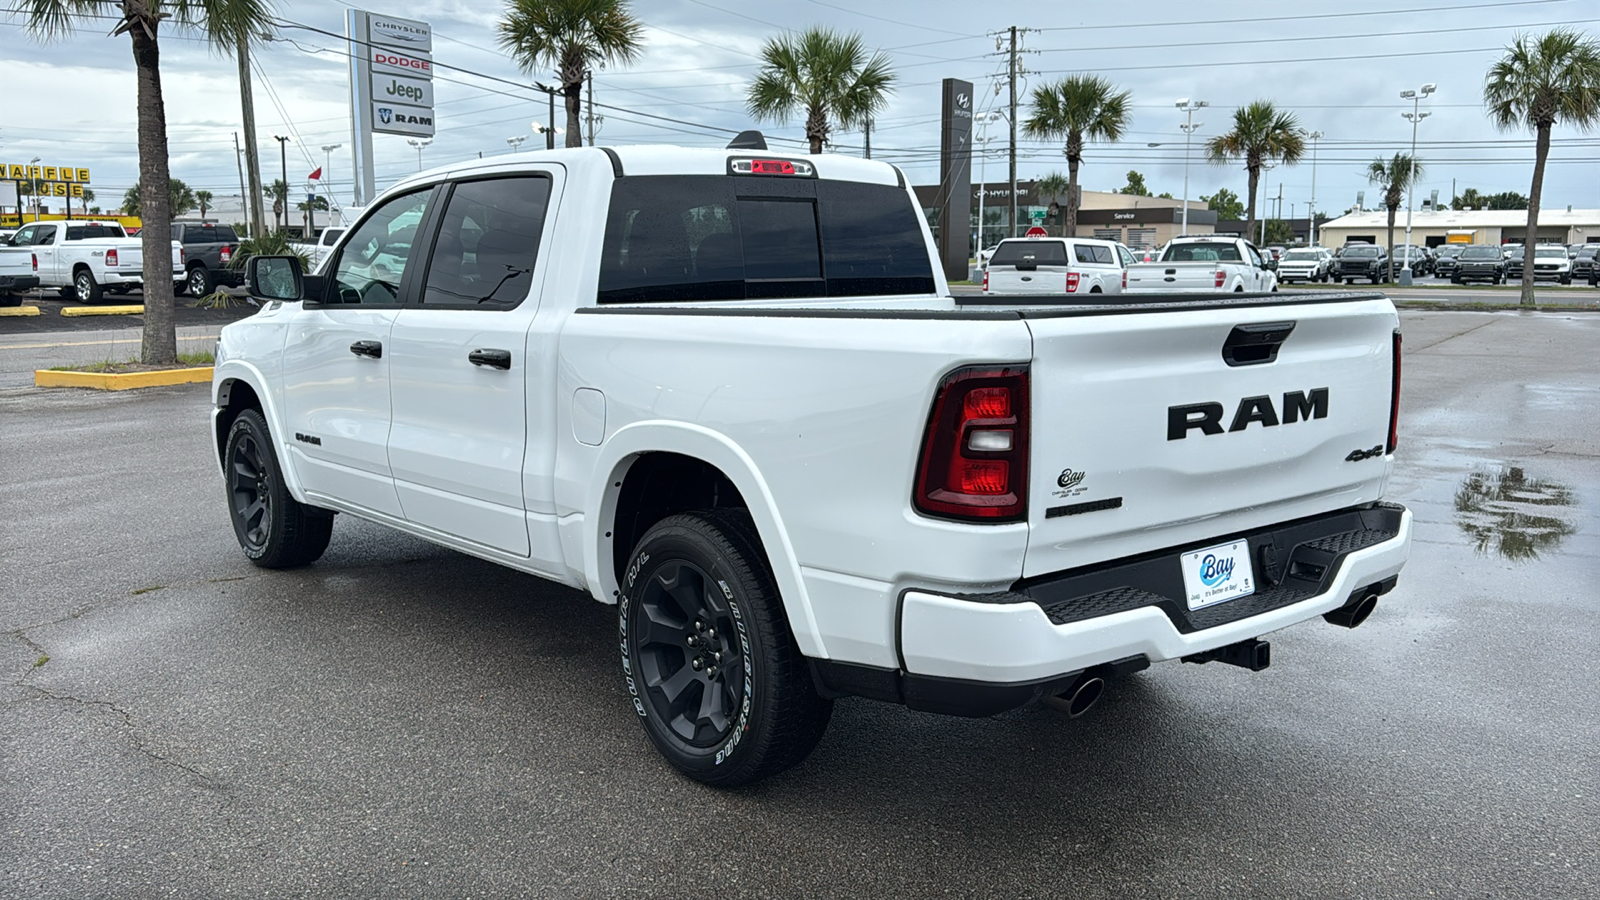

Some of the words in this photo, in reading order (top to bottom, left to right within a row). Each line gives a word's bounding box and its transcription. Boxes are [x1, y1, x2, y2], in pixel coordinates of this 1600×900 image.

[375, 21, 428, 35] CHRYSLER
[375, 54, 430, 70] DODGE
[386, 80, 423, 102] Jeep
[395, 114, 432, 126] RAM
[1113, 212, 1135, 220] Service
[1167, 387, 1329, 441] RAM
[1345, 444, 1383, 462] 4x4
[1058, 468, 1086, 488] Bay
[1202, 554, 1236, 581] Bay
[619, 595, 648, 718] DUELER
[716, 579, 752, 766] BRIDGESTONE
